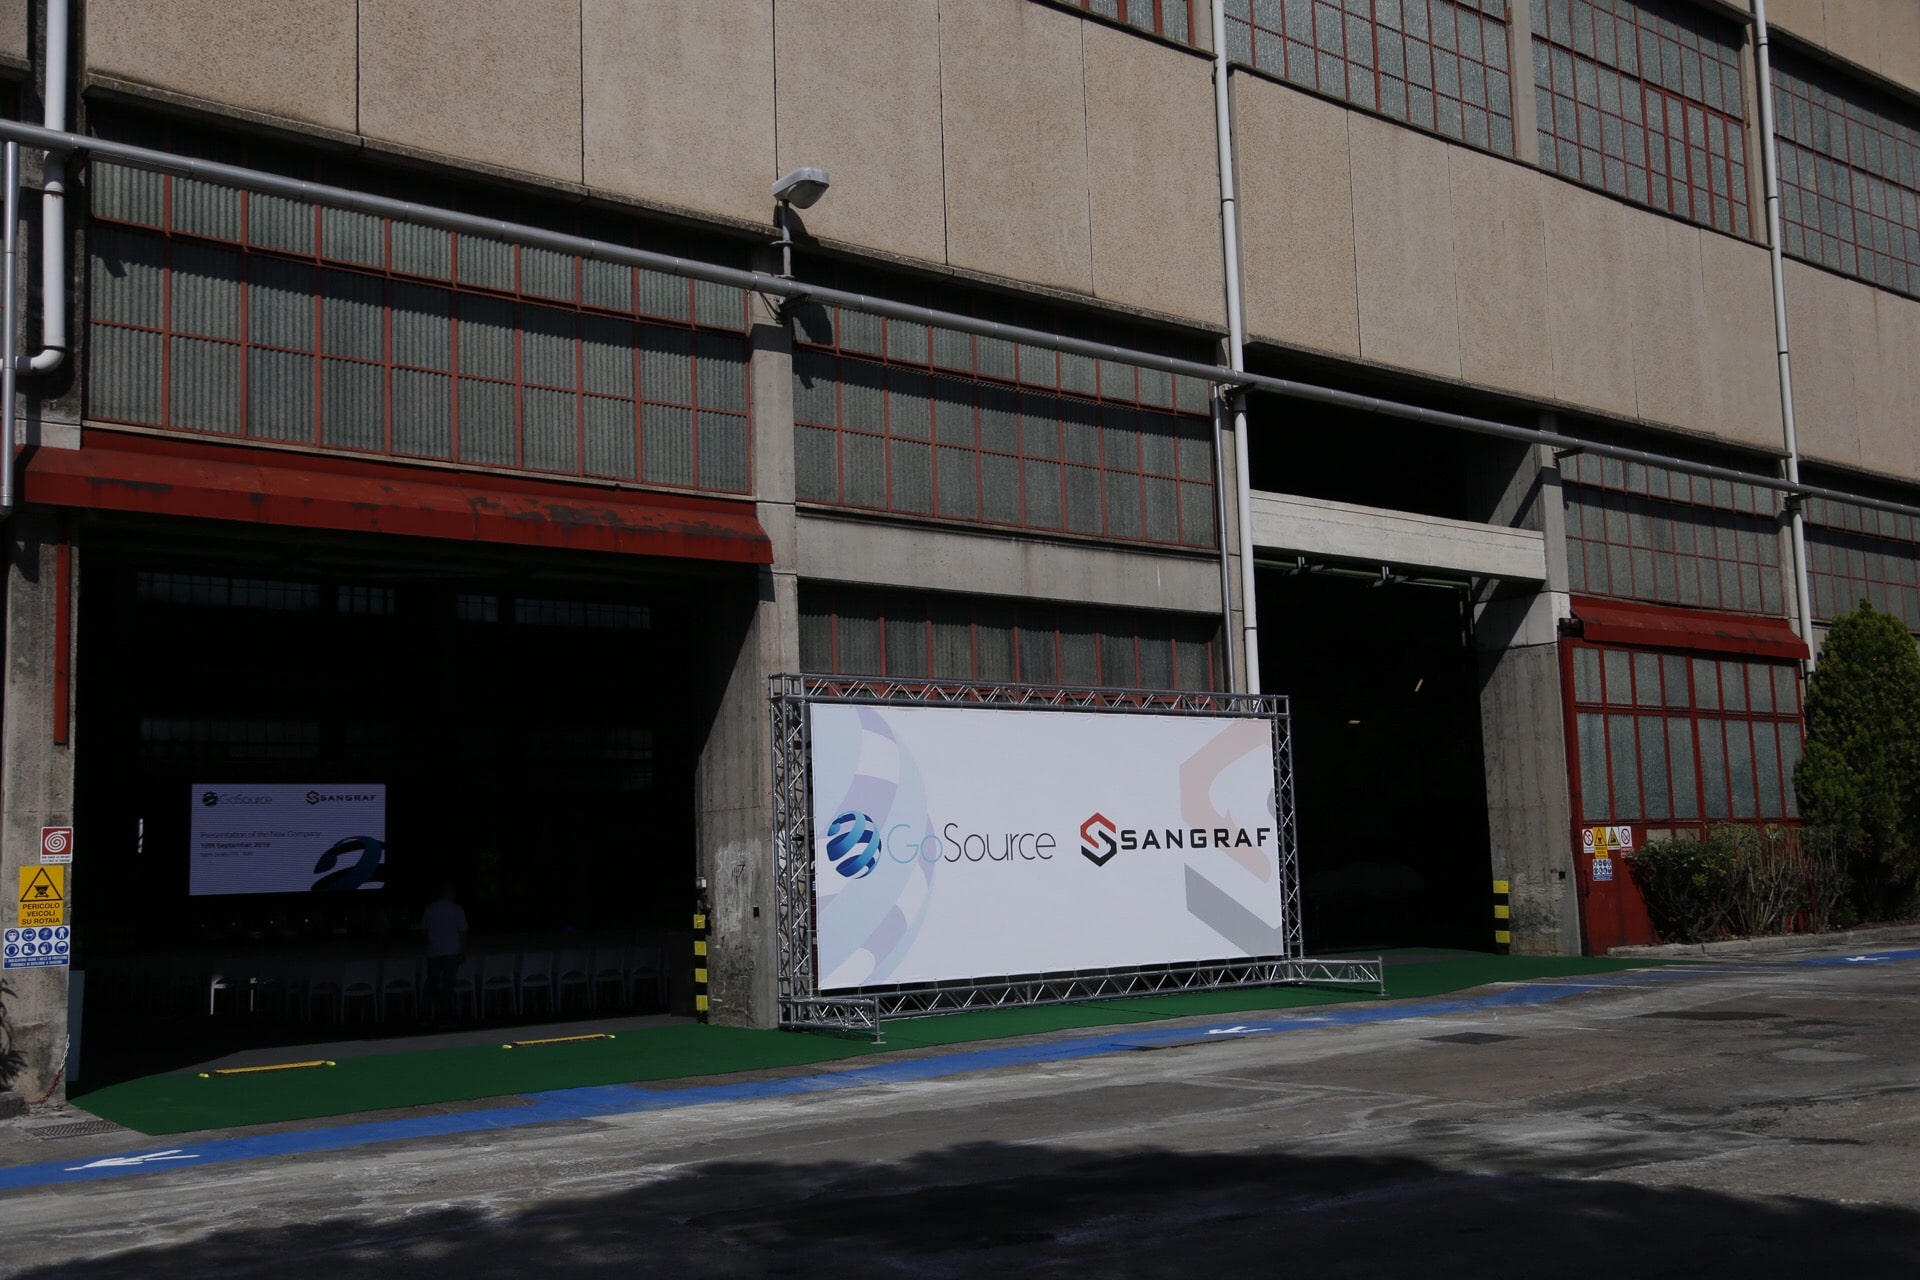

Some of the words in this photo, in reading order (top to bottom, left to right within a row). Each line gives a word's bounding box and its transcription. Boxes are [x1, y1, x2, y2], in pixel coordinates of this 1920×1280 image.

[219, 793, 273, 805] GoSource
[200, 831, 247, 840] Presentation
[256, 831, 270, 839] the
[288, 830, 321, 839] Company
[1120, 827, 1271, 850] SANGRAF
[886, 822, 1057, 864] GoSource
[22, 902, 61, 910] PERICOLO
[26, 910, 56, 918] VEICOLI
[33, 917, 61, 925] ROTAIA
